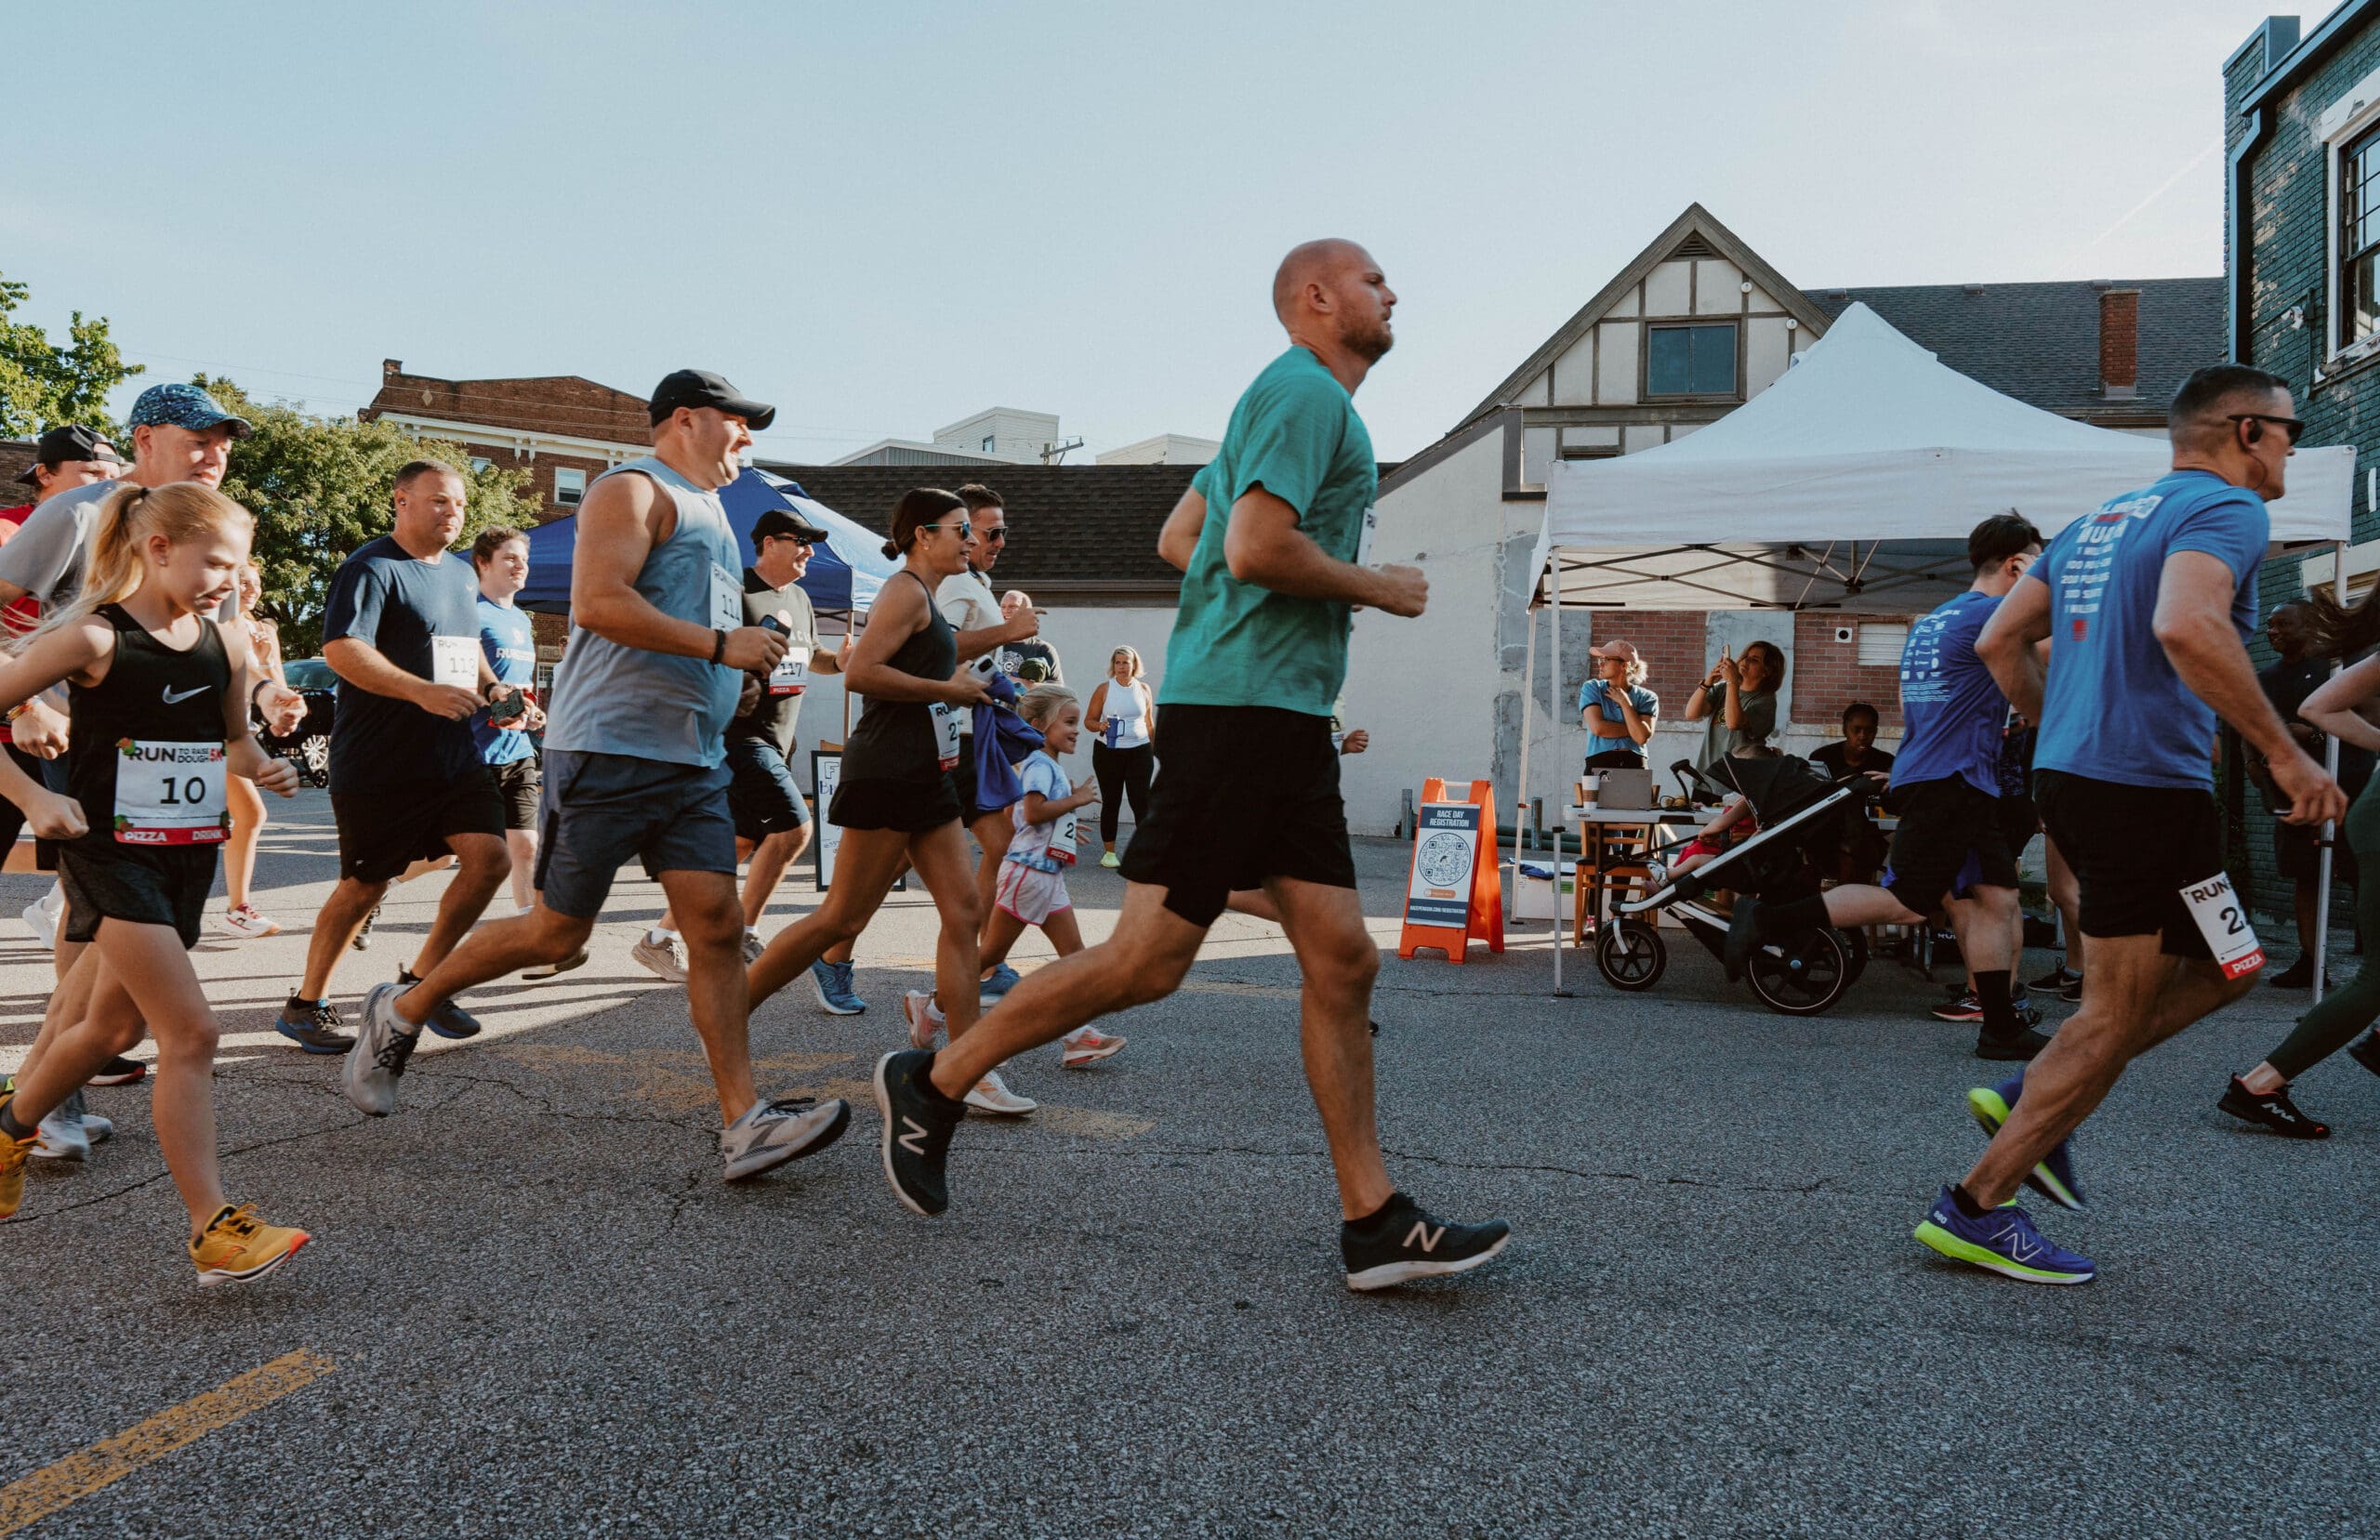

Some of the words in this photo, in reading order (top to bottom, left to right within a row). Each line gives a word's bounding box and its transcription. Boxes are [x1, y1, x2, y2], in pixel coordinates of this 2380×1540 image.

[780, 663, 802, 678] 117
[936, 703, 950, 717] RU
[128, 746, 176, 762] RUN
[178, 755, 209, 763] DOUGH
[160, 776, 206, 805] 10
[1436, 809, 1452, 819] RACE
[1452, 810, 1464, 819] DAY
[1429, 818, 1470, 827] REGISTRATION
[124, 831, 167, 842] PIZZA
[2190, 881, 2229, 903] RUN
